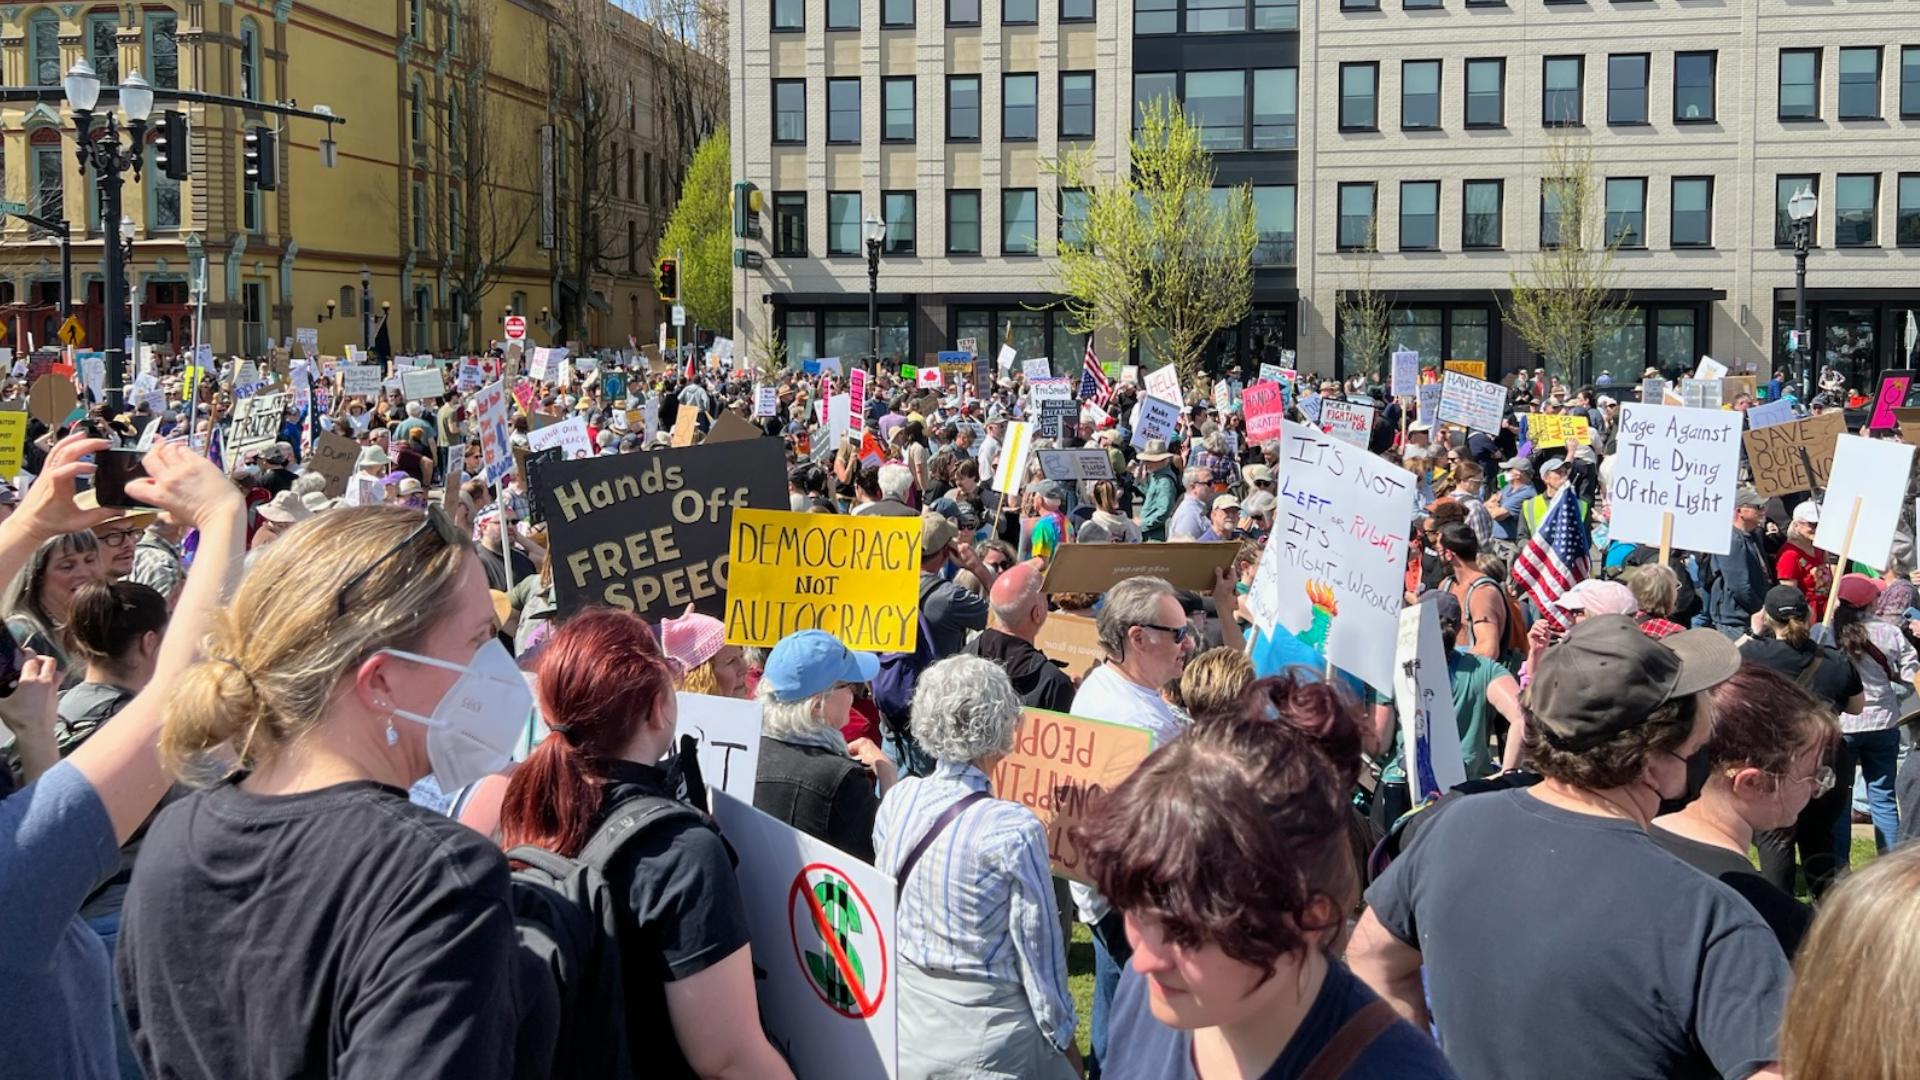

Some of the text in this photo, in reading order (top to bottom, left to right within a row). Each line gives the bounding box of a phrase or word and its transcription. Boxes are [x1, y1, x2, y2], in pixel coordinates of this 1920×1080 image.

[1149, 370, 1177, 393] HELL
[1245, 390, 1276, 407] HANDS
[1447, 372, 1506, 397] HANDS OFF
[1151, 405, 1168, 418] Make
[1328, 410, 1366, 422] FIGHTING
[1621, 408, 1732, 444] Rage Against
[1043, 426, 1056, 436] US
[1751, 420, 1815, 452] SAVE
[1290, 436, 1406, 496] IT'S NOT
[1628, 443, 1720, 485] The Dying
[1757, 446, 1801, 472] OUR
[1761, 458, 1833, 493] SCIENC
[553, 455, 684, 522] Hands
[671, 486, 749, 524] Off
[1282, 475, 1332, 514] LEFT
[1616, 476, 1723, 514] Of the Light
[738, 522, 921, 571] DEMOCRACY
[1288, 512, 1330, 548] IT'S
[566, 525, 681, 588] FREE
[1284, 541, 1337, 580] RIGHT
[603, 554, 729, 612] SPEEC
[795, 575, 839, 595] NOT
[728, 599, 917, 646] AUTOCRACY
